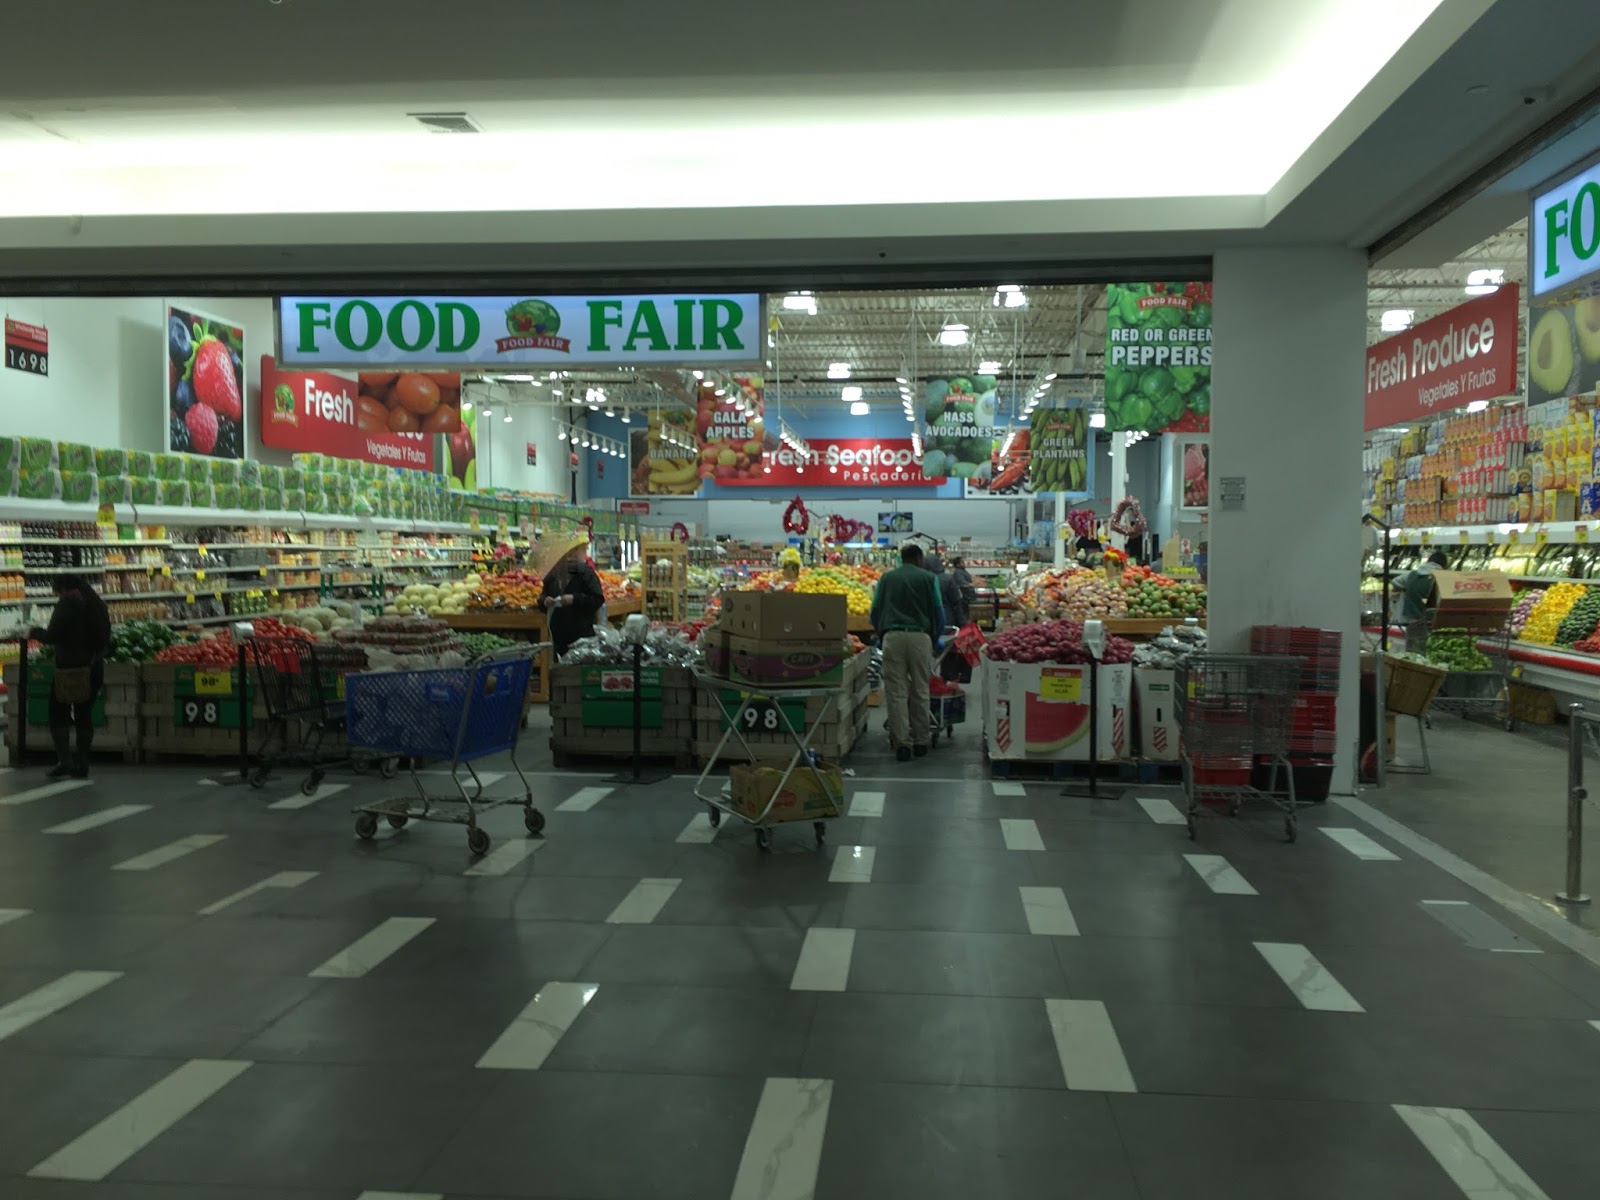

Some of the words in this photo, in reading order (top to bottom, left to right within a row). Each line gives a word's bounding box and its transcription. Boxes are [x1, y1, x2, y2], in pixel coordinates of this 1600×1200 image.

[1544, 181, 1600, 279] FO
[1142, 298, 1166, 307] FOOD
[1168, 297, 1188, 306] FAIR
[295, 299, 480, 353] FOOD
[586, 299, 745, 352] FAIR
[502, 337, 534, 349] FOOD
[537, 337, 564, 349] FAIR
[1111, 328, 1139, 342] RED
[1144, 328, 1163, 342] OR
[1112, 346, 1212, 366] PEPPERS
[1367, 345, 1407, 394] Fresh
[1412, 317, 1495, 379] Produce
[1418, 378, 1460, 407] Vegetales
[1460, 374, 1468, 393] Y
[1468, 368, 1496, 389] Frutas
[304, 378, 354, 425] Fresh
[713, 411, 746, 423] GALA
[944, 411, 974, 423] HASS
[706, 426, 755, 439] APPLES
[925, 426, 993, 438] AVOCADOES
[366, 438, 401, 461] Vegetales
[402, 446, 408, 460] Y
[407, 447, 426, 464] Frutas
[1043, 438, 1074, 447] GREEN
[1033, 450, 1085, 459] PLANTAINS
[185, 702, 217, 723] 98
[744, 707, 778, 729] 98
